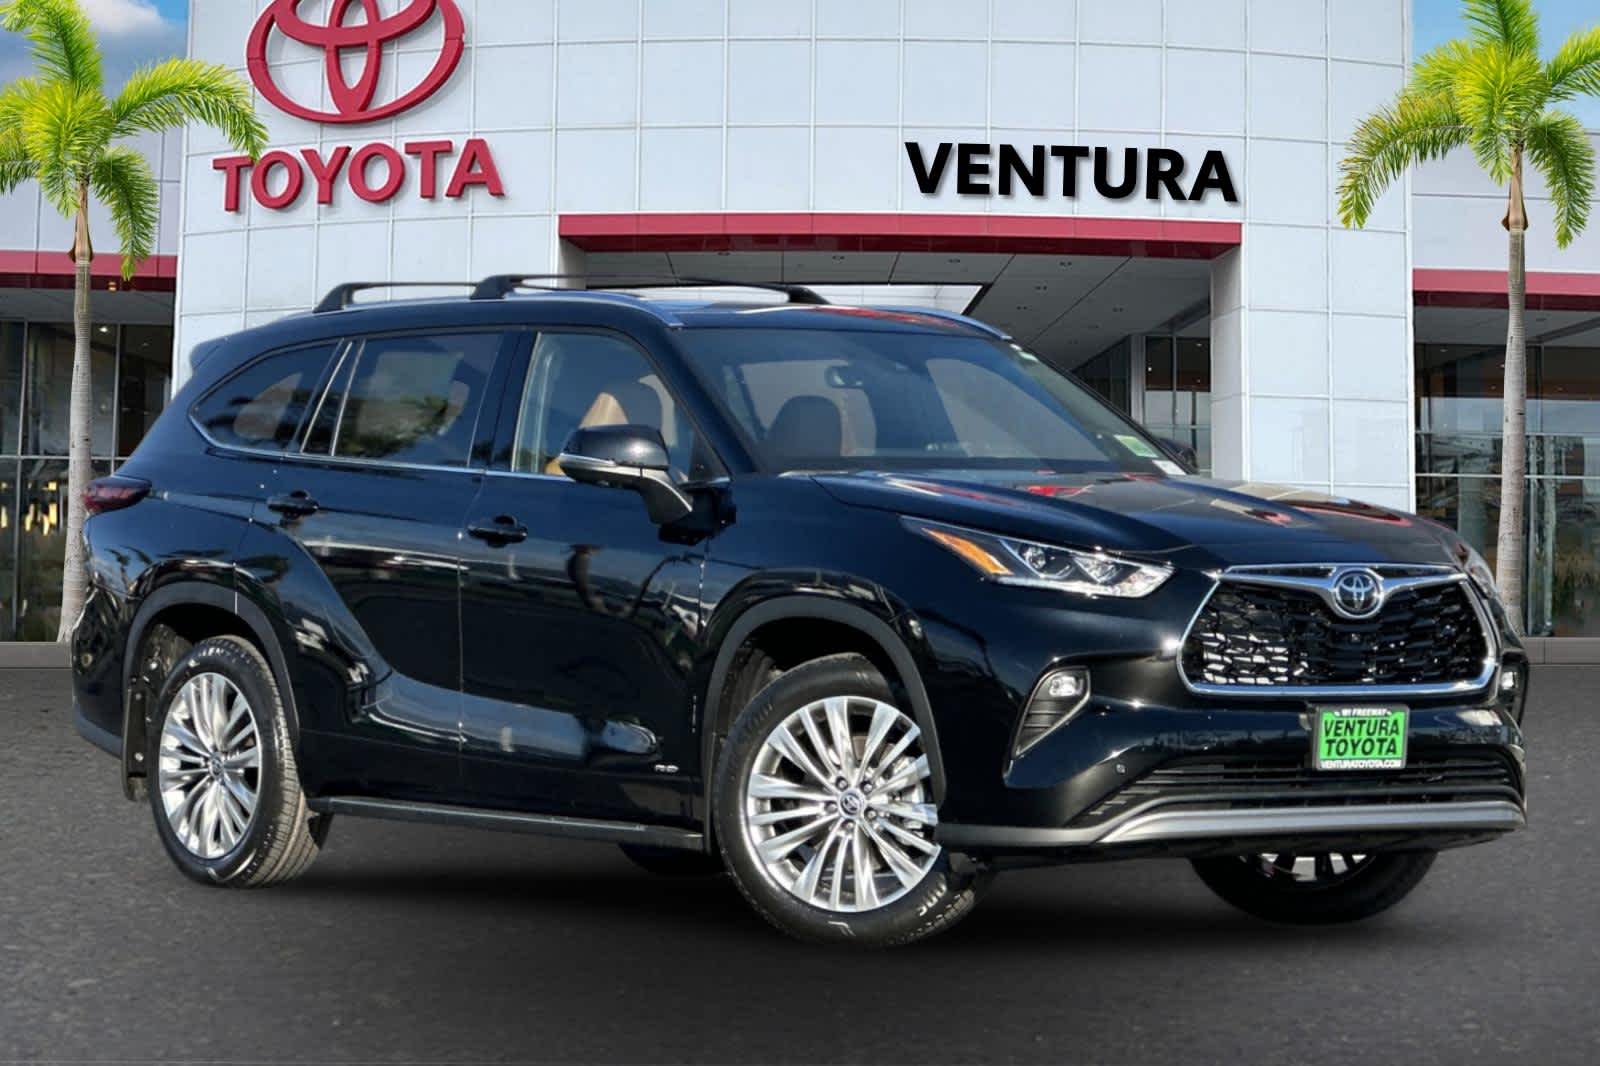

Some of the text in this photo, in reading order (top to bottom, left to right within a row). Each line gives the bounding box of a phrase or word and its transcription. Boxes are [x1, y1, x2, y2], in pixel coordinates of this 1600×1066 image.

[212, 138, 505, 212] TOYOTA
[904, 142, 1239, 202] VENTURA
[1324, 719, 1399, 737] VENTURA
[1325, 738, 1397, 756] TOYOTA
